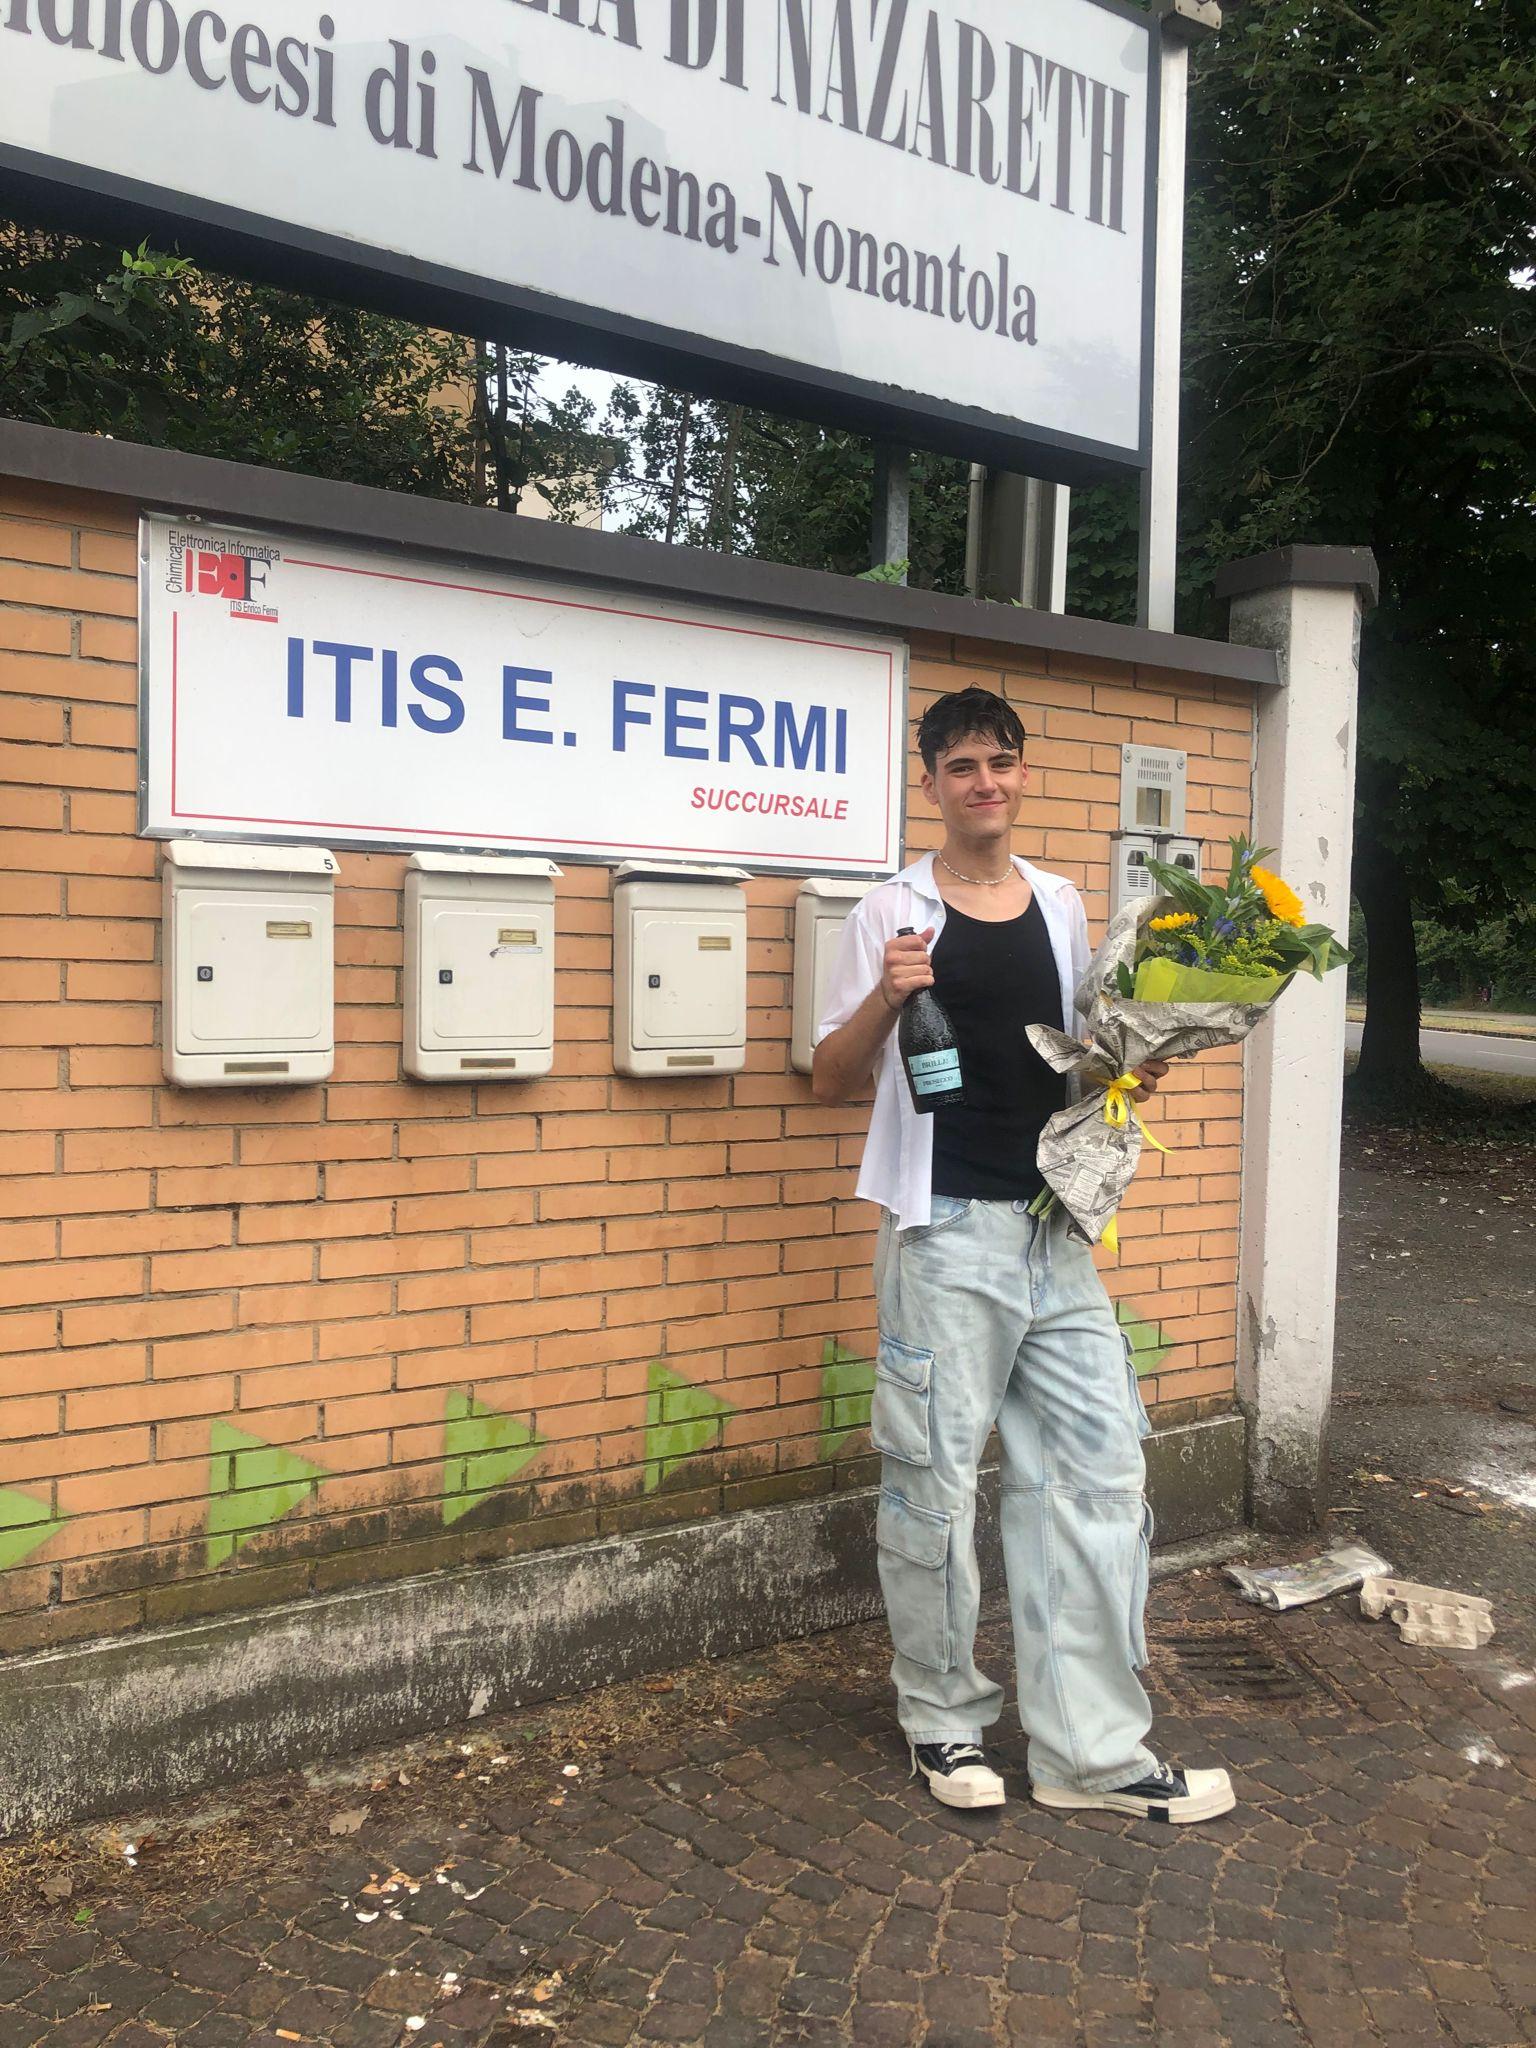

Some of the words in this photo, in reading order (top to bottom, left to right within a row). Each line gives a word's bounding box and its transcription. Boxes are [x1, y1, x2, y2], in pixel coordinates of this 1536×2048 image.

[770, 0, 1130, 235] NAZARETH
[365, 38, 438, 160] di
[462, 64, 1038, 347] Modena-Nonantola
[168, 530, 226, 553] Elettronica
[228, 540, 281, 561] Informatica
[166, 546, 183, 594] Chimica
[243, 602, 262, 614] Enrico
[262, 604, 279, 616] Fermi
[286, 636, 466, 735] ITIS
[502, 664, 578, 748] E.
[612, 679, 848, 775] FERMI
[690, 786, 850, 821] SUCCURSALE
[323, 858, 335, 871] 5
[548, 864, 557, 873] 4
